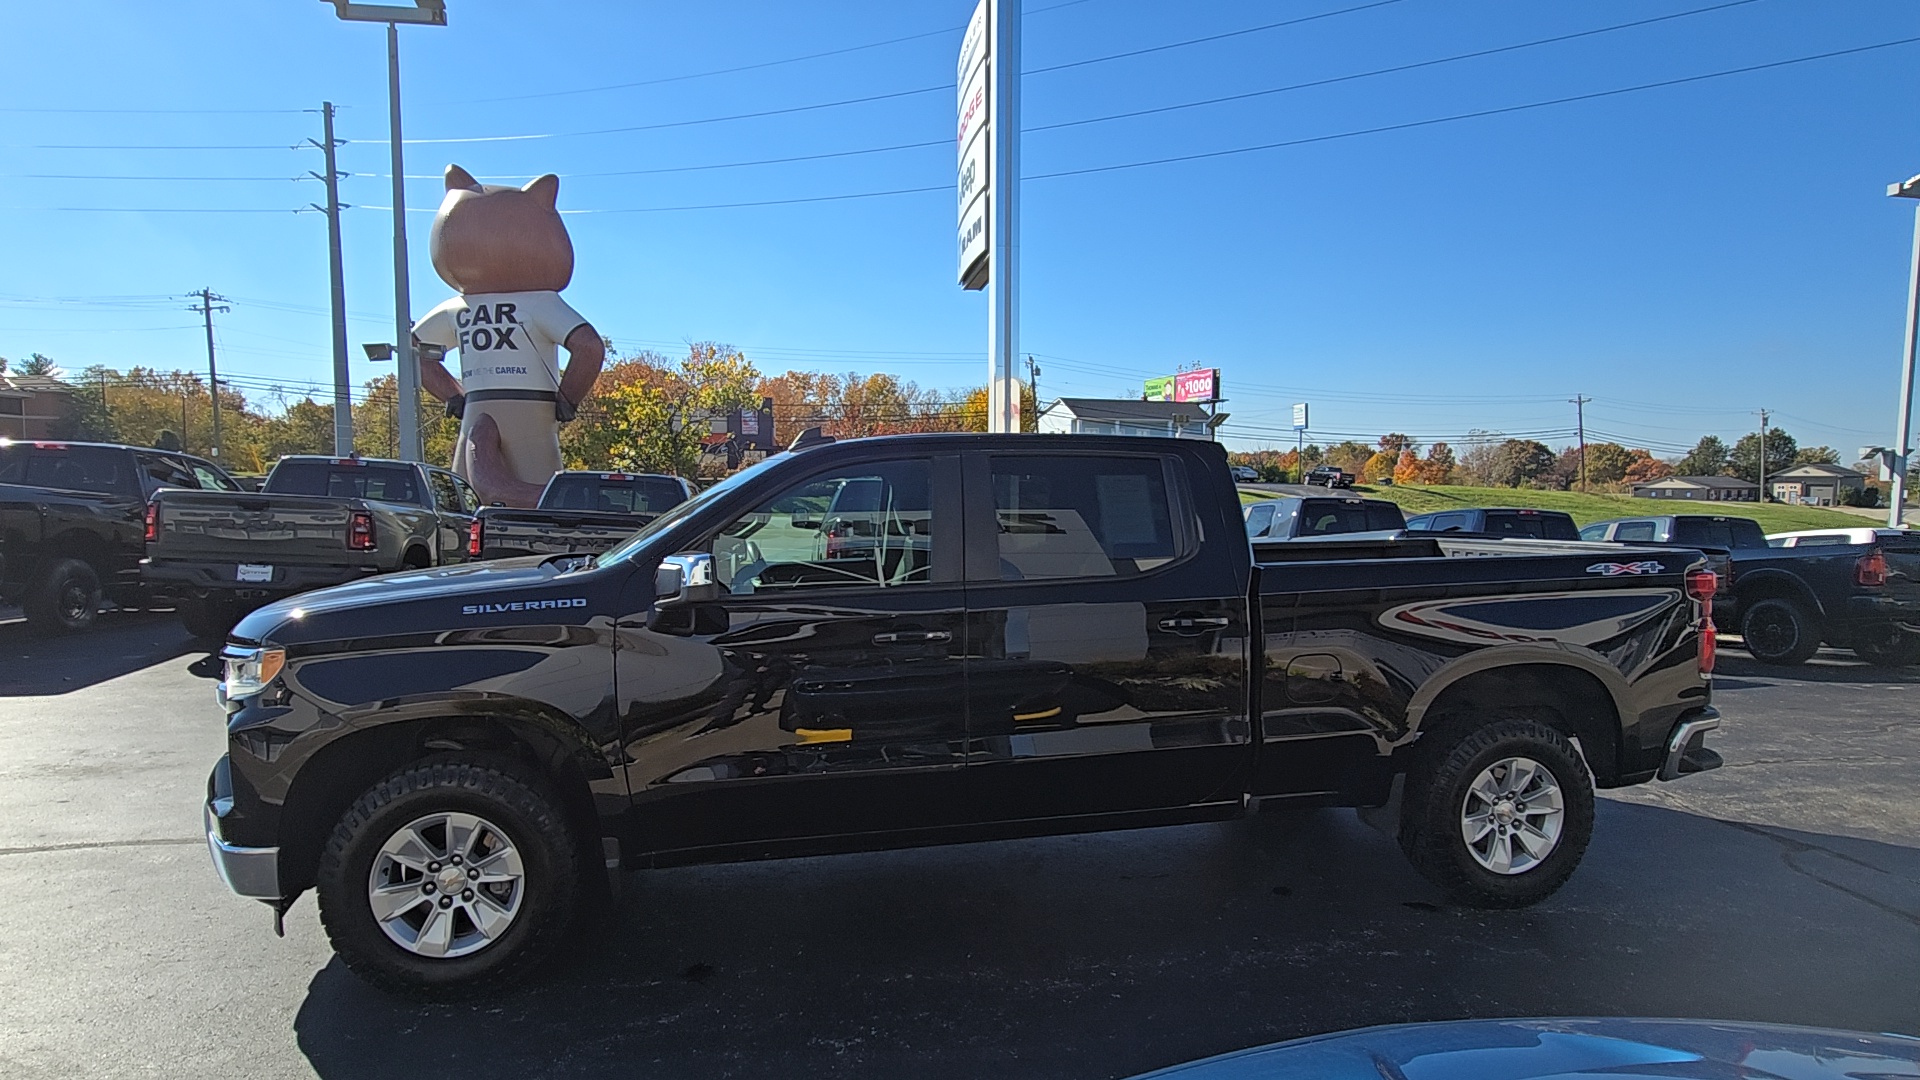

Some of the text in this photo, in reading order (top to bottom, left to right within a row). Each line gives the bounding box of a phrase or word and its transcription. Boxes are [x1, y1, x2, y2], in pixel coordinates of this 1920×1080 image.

[456, 303, 518, 328] CAR
[459, 327, 519, 355] FOX
[495, 366, 527, 374] CARFAX
[462, 599, 587, 614] SILVERADO
